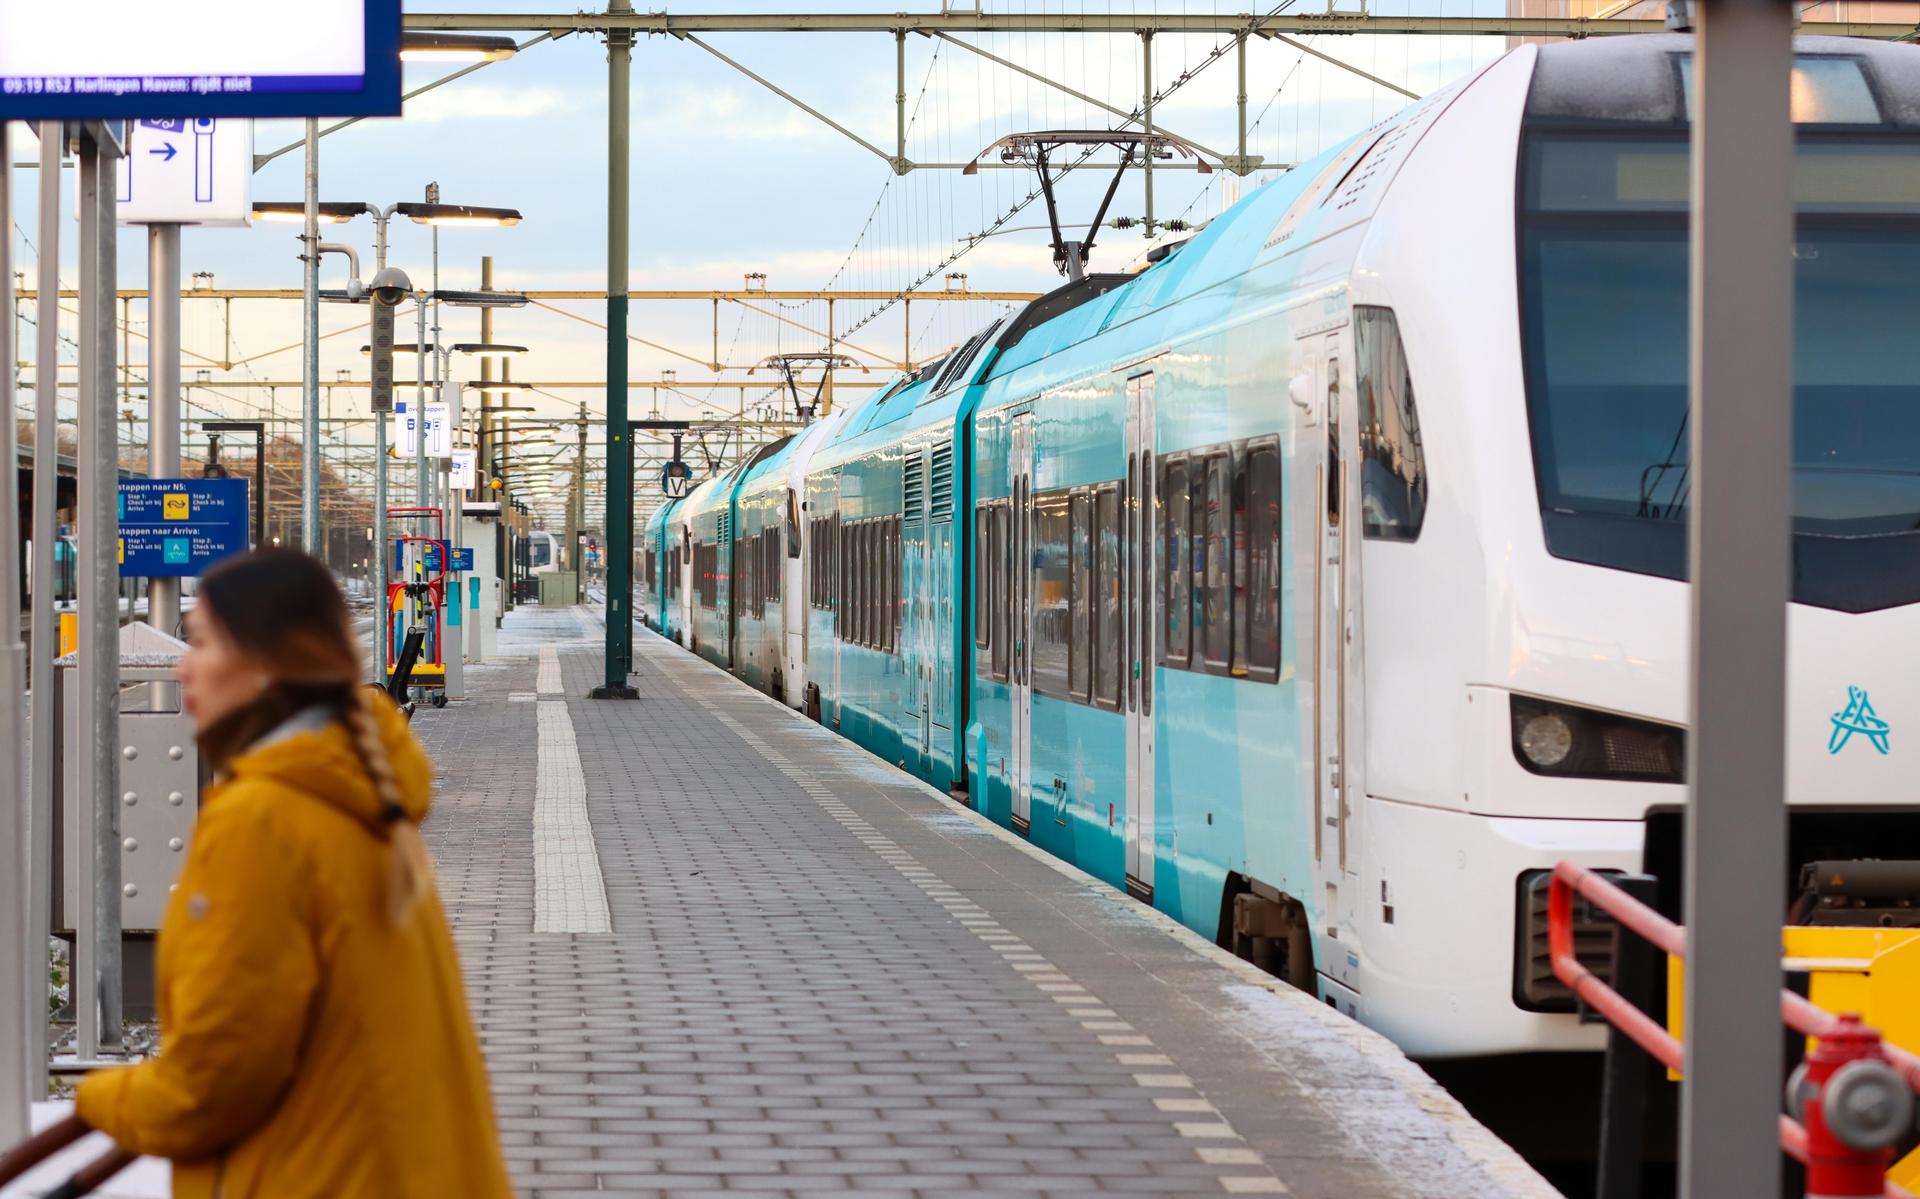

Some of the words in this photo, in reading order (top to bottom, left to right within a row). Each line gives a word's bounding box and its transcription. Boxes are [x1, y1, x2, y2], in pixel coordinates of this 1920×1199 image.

[4, 77, 43, 93] 09:19
[73, 76, 141, 96] Harlingen
[142, 76, 190, 92] Haven:
[192, 76, 221, 95] rijdt
[223, 76, 252, 92] niet
[118, 483, 150, 492] stappen
[173, 483, 186, 491] NS:
[670, 478, 683, 495] V
[118, 528, 150, 537] stappen
[173, 527, 200, 535] Arriva:
